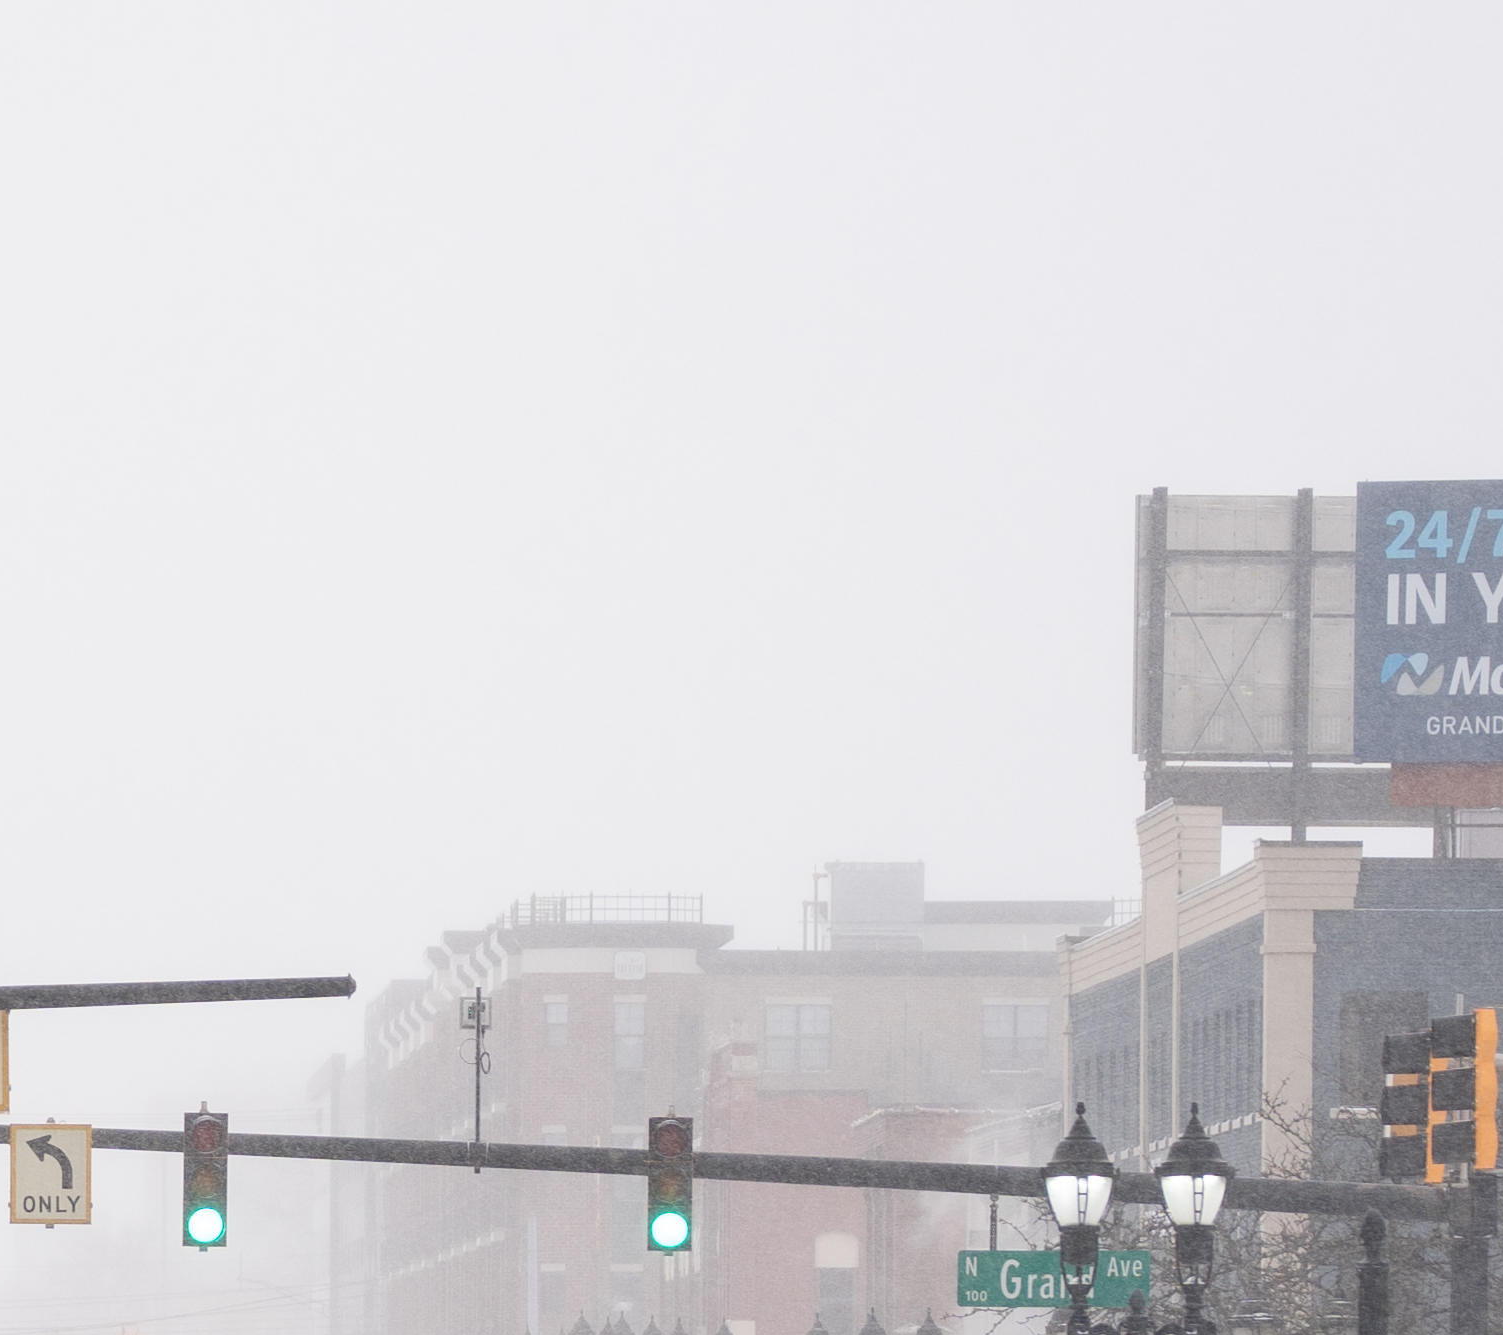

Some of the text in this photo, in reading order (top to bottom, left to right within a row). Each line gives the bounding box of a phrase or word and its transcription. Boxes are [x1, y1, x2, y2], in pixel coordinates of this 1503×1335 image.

[1386, 573, 1447, 625] IN
[23, 1195, 81, 1213] ONLY
[965, 1256, 978, 1277] N
[1107, 1257, 1144, 1277] Ave
[965, 1290, 988, 1302] 100
